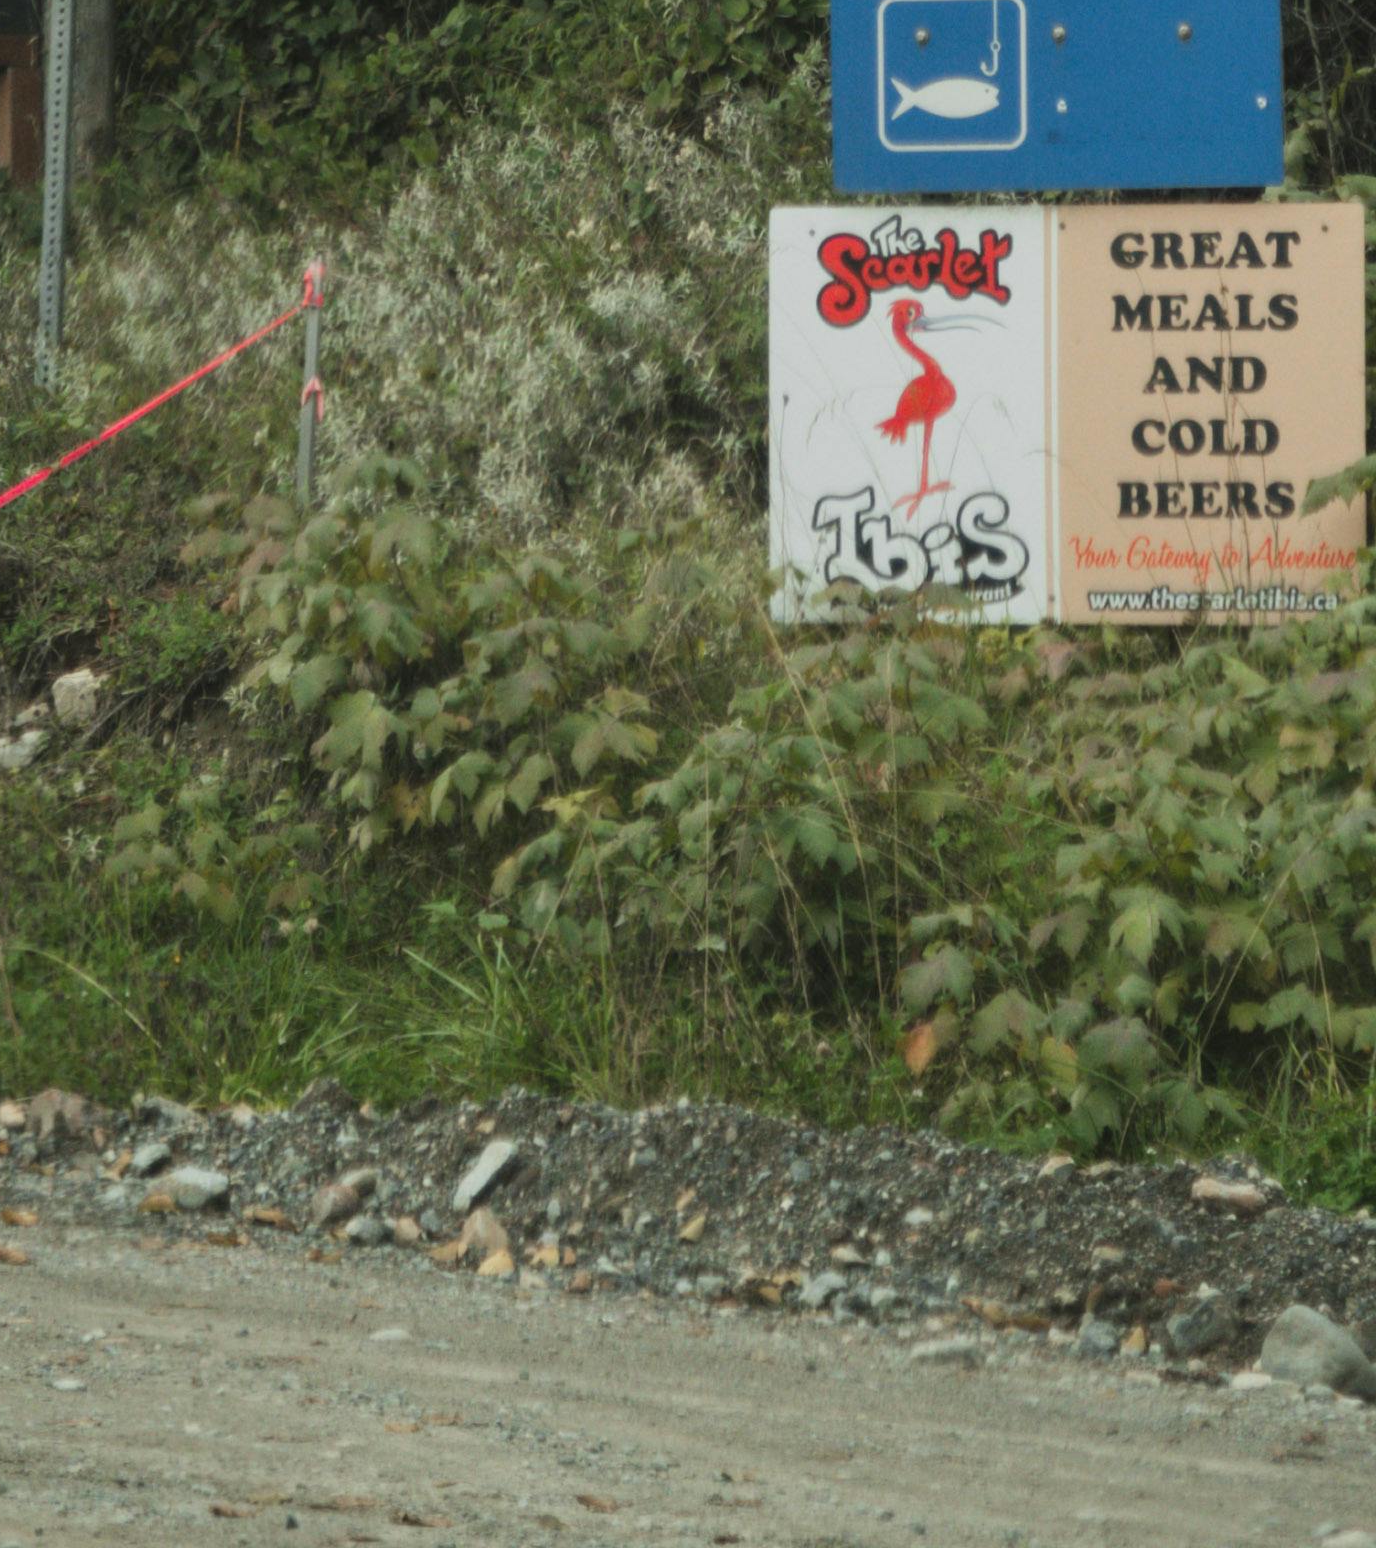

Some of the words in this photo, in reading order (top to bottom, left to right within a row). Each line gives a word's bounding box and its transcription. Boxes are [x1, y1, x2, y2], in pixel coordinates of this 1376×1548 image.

[871, 215, 921, 256] The
[1109, 230, 1301, 271] GREAT
[1111, 293, 1299, 332] MEALS
[1142, 355, 1267, 395] AND
[1131, 418, 1279, 457] COLD
[1117, 481, 1296, 519] BEERS
[1069, 535, 1120, 570] Your
[1126, 534, 1213, 586] Gateway
